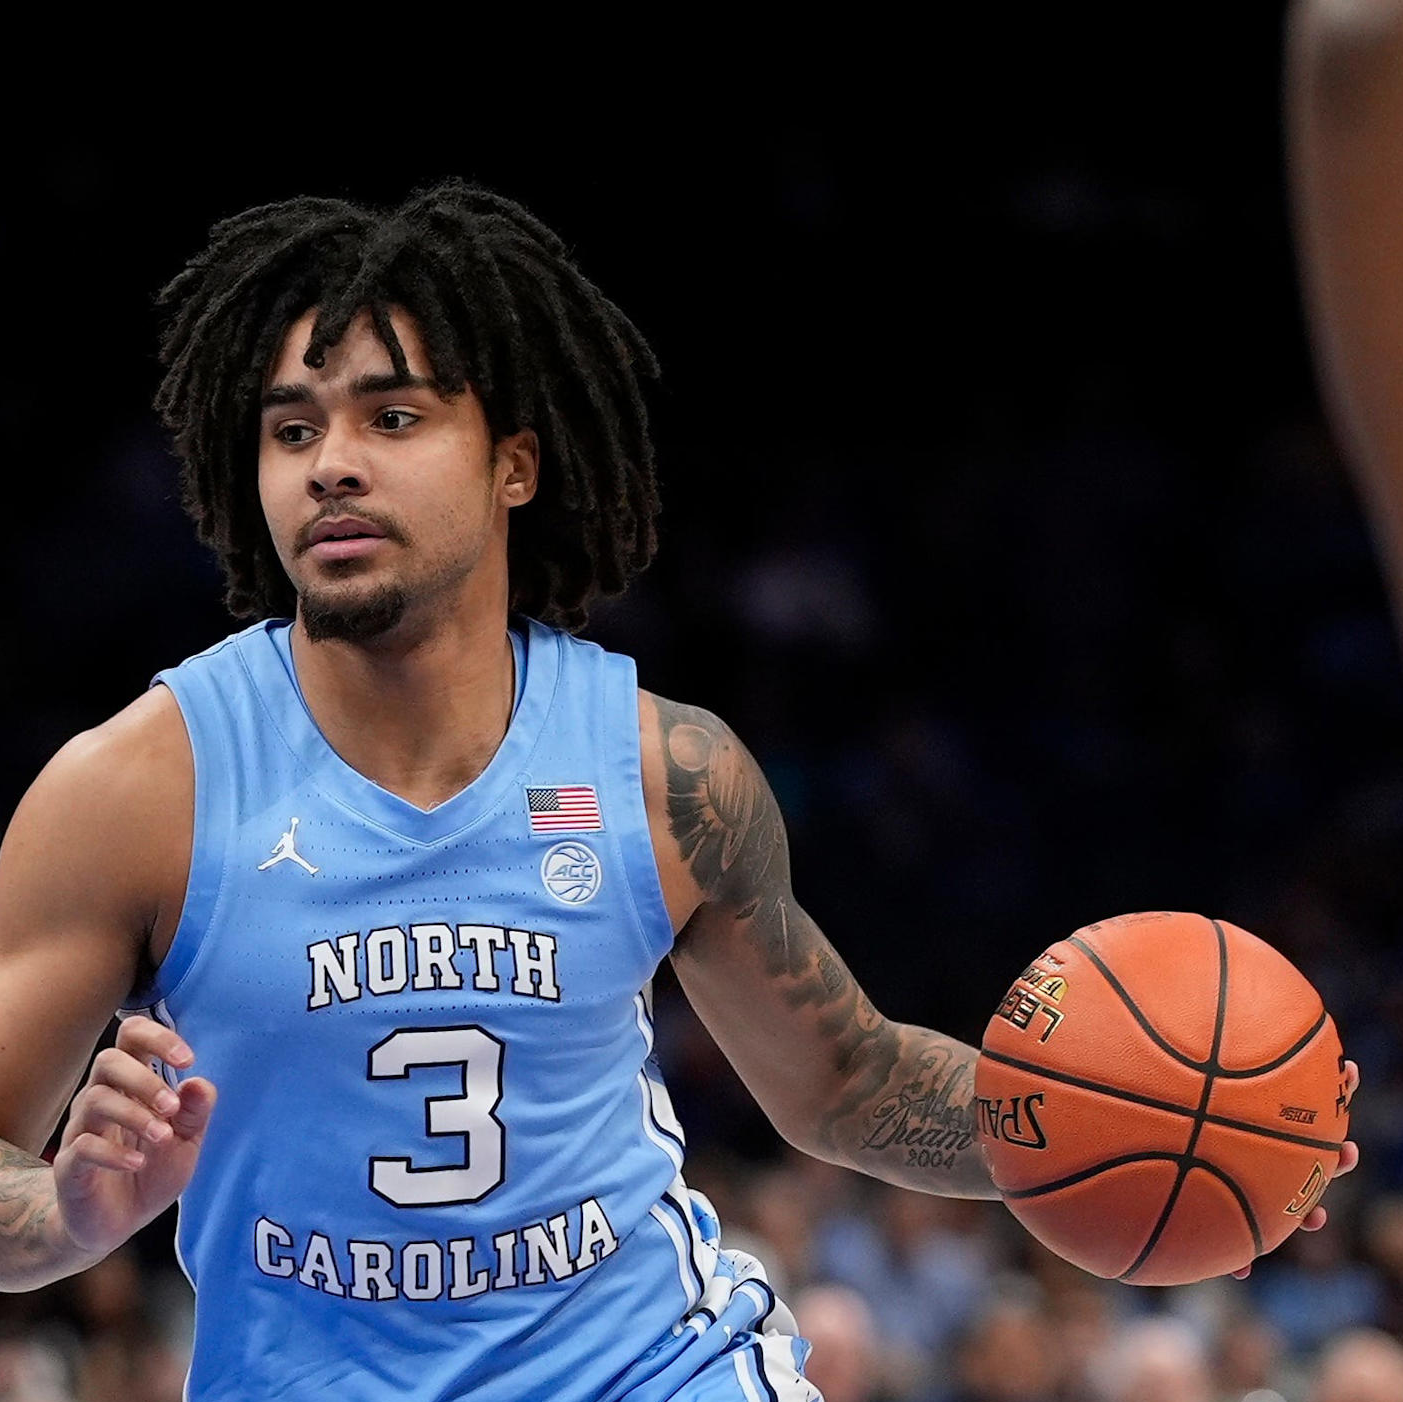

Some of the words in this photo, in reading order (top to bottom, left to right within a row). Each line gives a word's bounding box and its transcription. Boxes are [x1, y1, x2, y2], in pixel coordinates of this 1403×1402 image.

[551, 864, 596, 878] ACC
[307, 923, 561, 1011] NORTH
[996, 987, 1066, 1044] LEG
[367, 1025, 506, 1207] 3
[860, 1095, 974, 1152] Dream
[974, 1092, 1049, 1152] SPAL
[907, 1148, 957, 1170] 2004
[254, 1197, 619, 1302] CAROLINA
